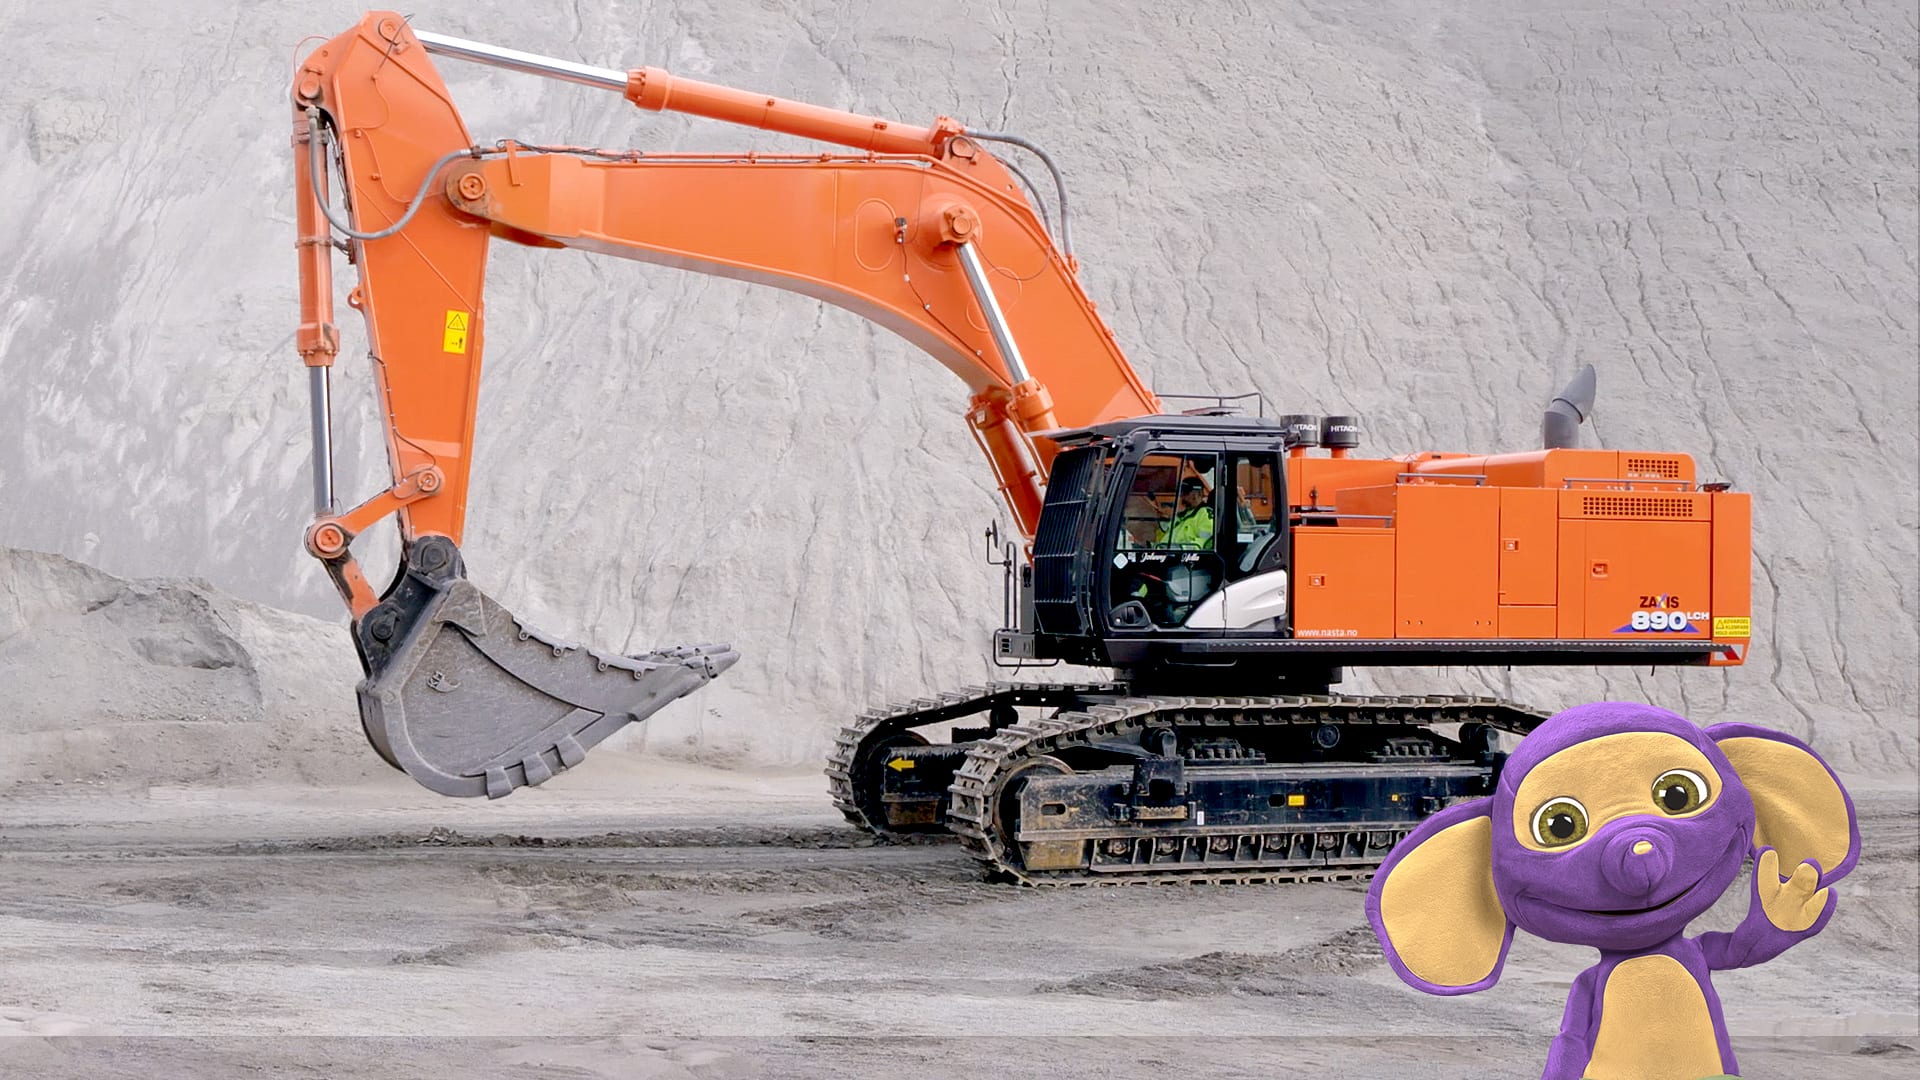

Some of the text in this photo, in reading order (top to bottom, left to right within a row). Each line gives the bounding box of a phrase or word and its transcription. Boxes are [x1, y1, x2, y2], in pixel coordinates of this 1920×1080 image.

[1330, 425, 1358, 433] HITACH
[1639, 592, 1679, 609] ZAXIS
[1631, 611, 1687, 632] 890
[1297, 629, 1358, 638] www.nasta.no
